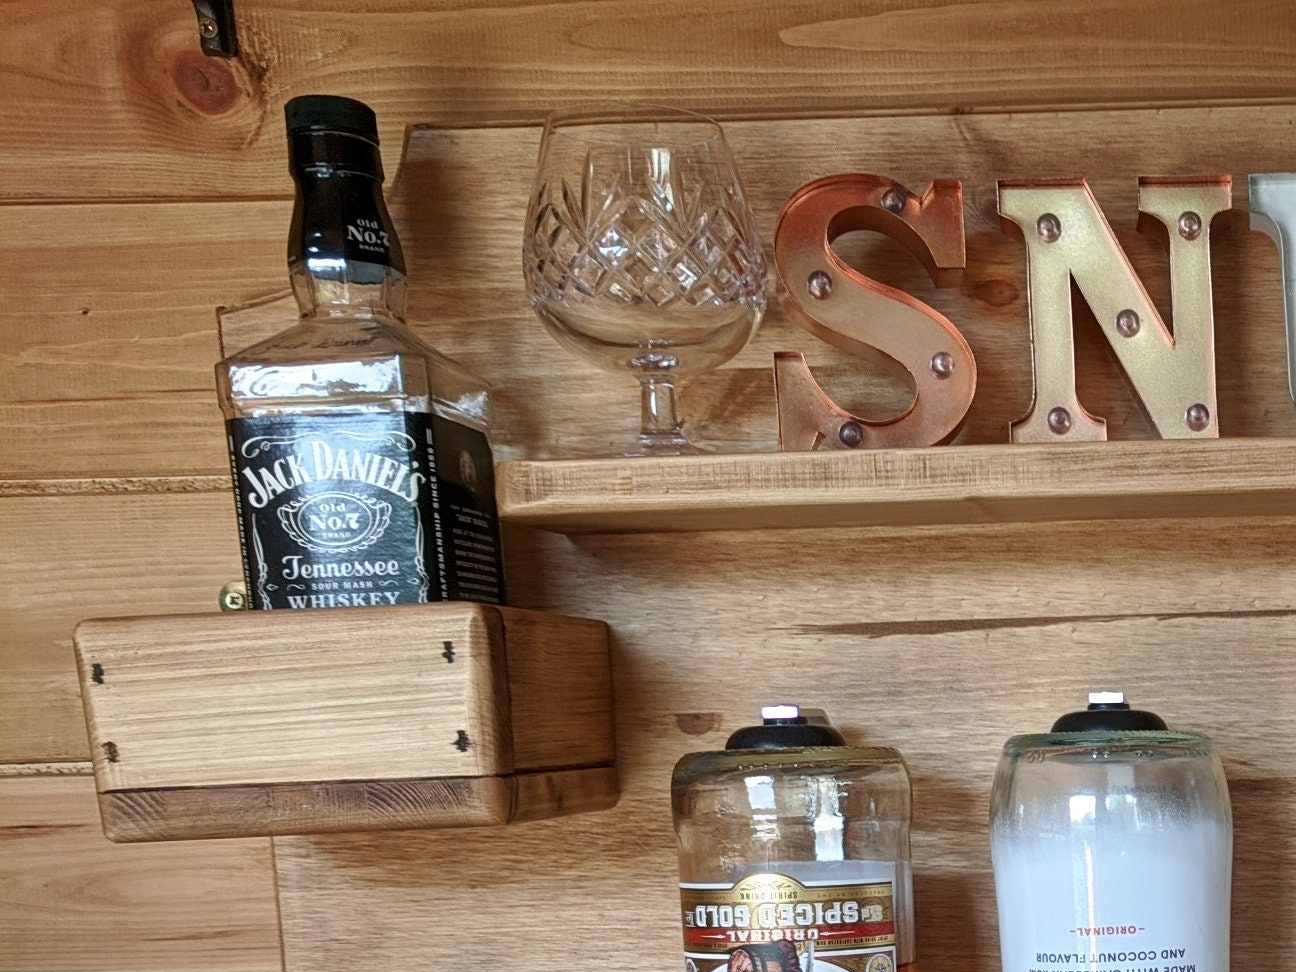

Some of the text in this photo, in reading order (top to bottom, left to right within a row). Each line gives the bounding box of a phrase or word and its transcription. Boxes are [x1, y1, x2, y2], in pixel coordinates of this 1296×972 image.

[242, 452, 312, 508] JACK
[319, 503, 346, 512] Old
[432, 512, 449, 602] RAFTSMANSHIP
[282, 555, 399, 580] Tennessee
[311, 581, 373, 590] SOUR MASH
[287, 591, 400, 610] WHISKEY
[771, 891, 797, 899] SPIRIT
[695, 905, 750, 928] GOLD
[756, 901, 858, 928] SPICED
[726, 928, 819, 943] ORIGINAL
[1036, 948, 1186, 963] AND COCONUT FLAVOUR
